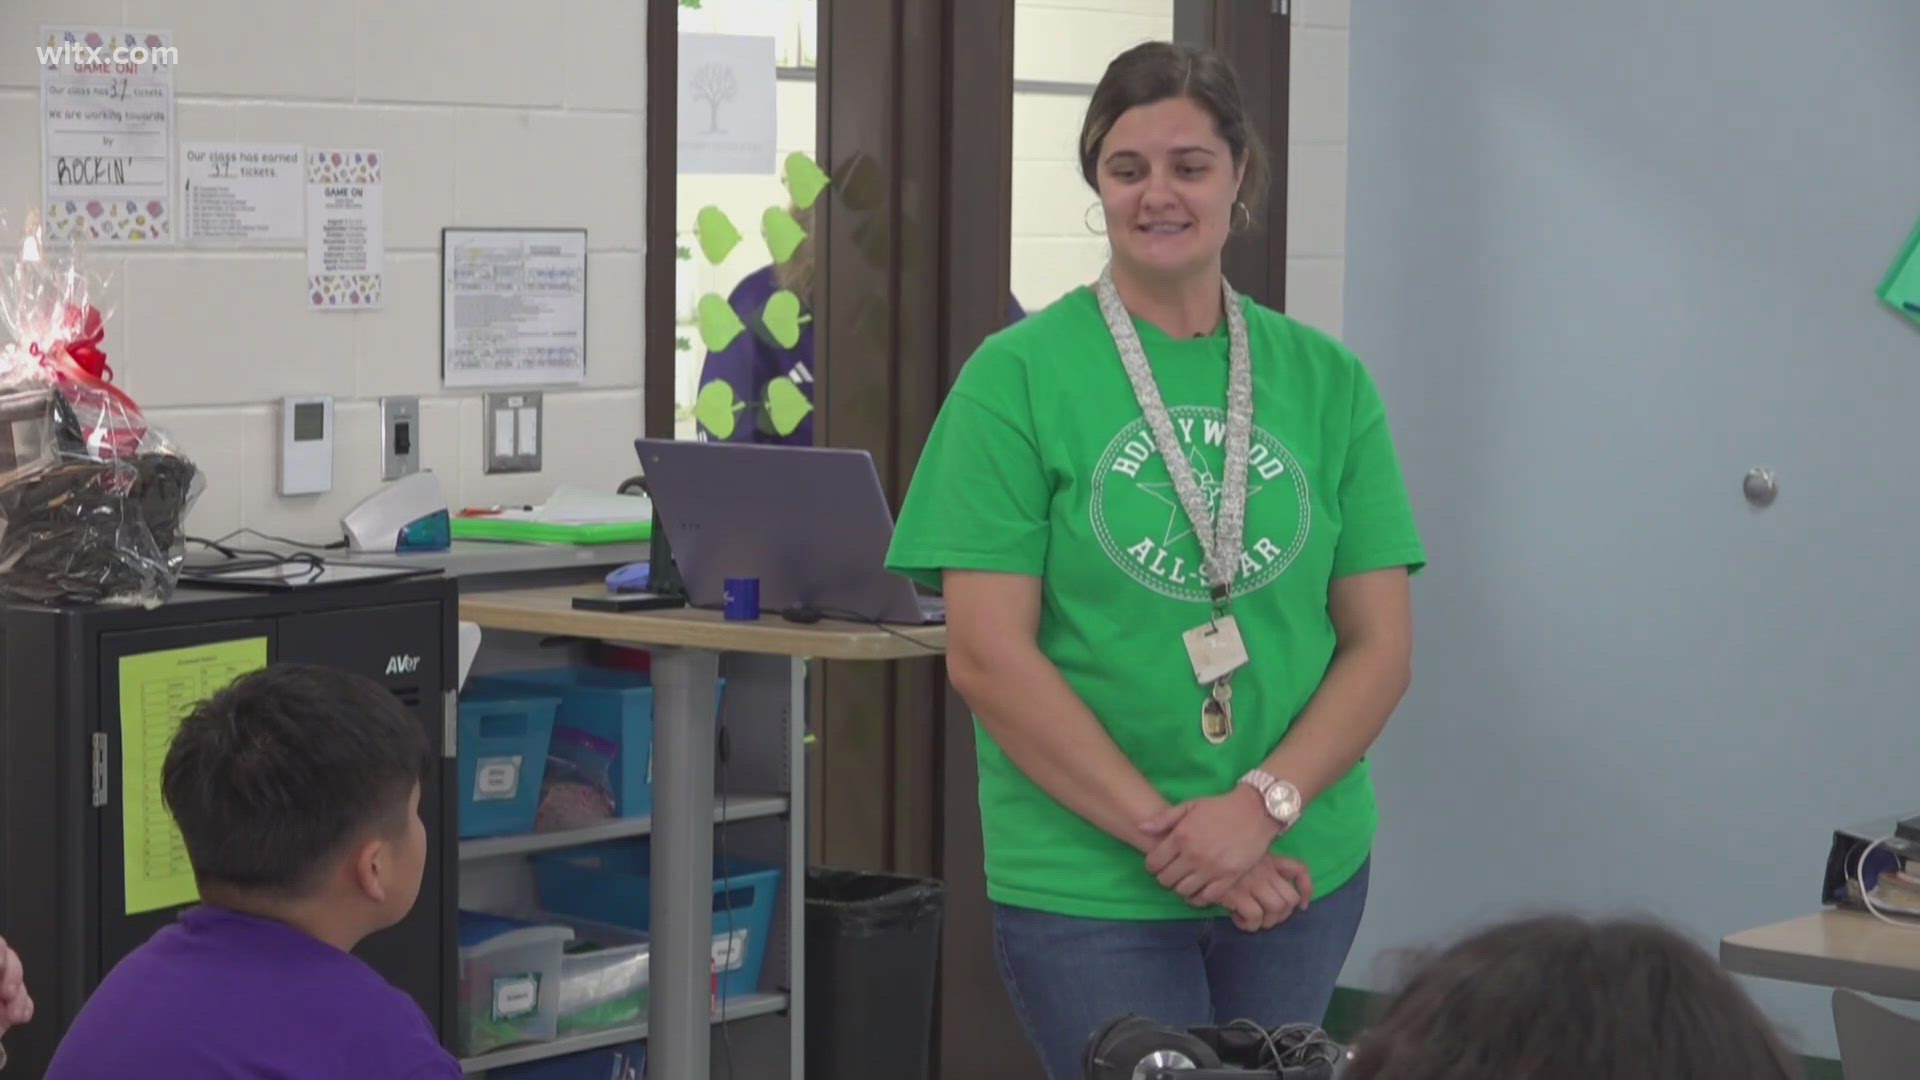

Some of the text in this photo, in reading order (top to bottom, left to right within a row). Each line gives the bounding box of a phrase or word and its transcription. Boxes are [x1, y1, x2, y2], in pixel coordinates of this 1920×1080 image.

[73, 61, 111, 74] GAME
[49, 109, 61, 119] We
[65, 111, 81, 119] are
[85, 109, 122, 123] working
[187, 150, 298, 163] Our class has earned
[325, 187, 363, 197] GAME ON
[1111, 418, 1285, 480] HOLYWOD
[1127, 536, 1282, 587] ALL-SAR
[385, 654, 420, 675] AVer
